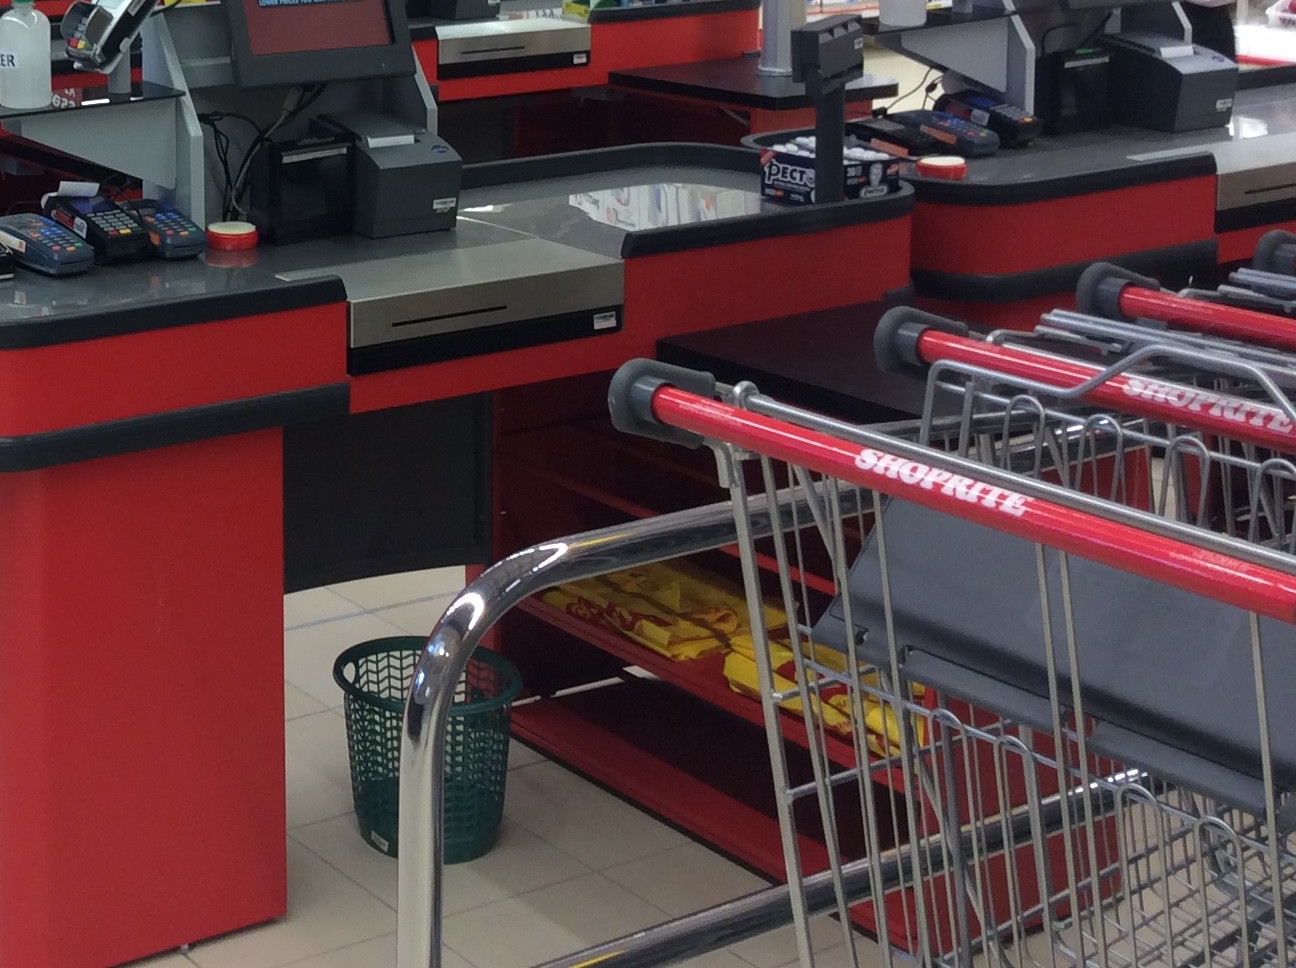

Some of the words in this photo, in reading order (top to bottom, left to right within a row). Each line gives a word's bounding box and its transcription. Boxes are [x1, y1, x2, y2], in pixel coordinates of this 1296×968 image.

[765, 159, 816, 187] PECTO
[1123, 379, 1293, 433] SHOPRITE
[855, 447, 1027, 517] SHOPRITE
